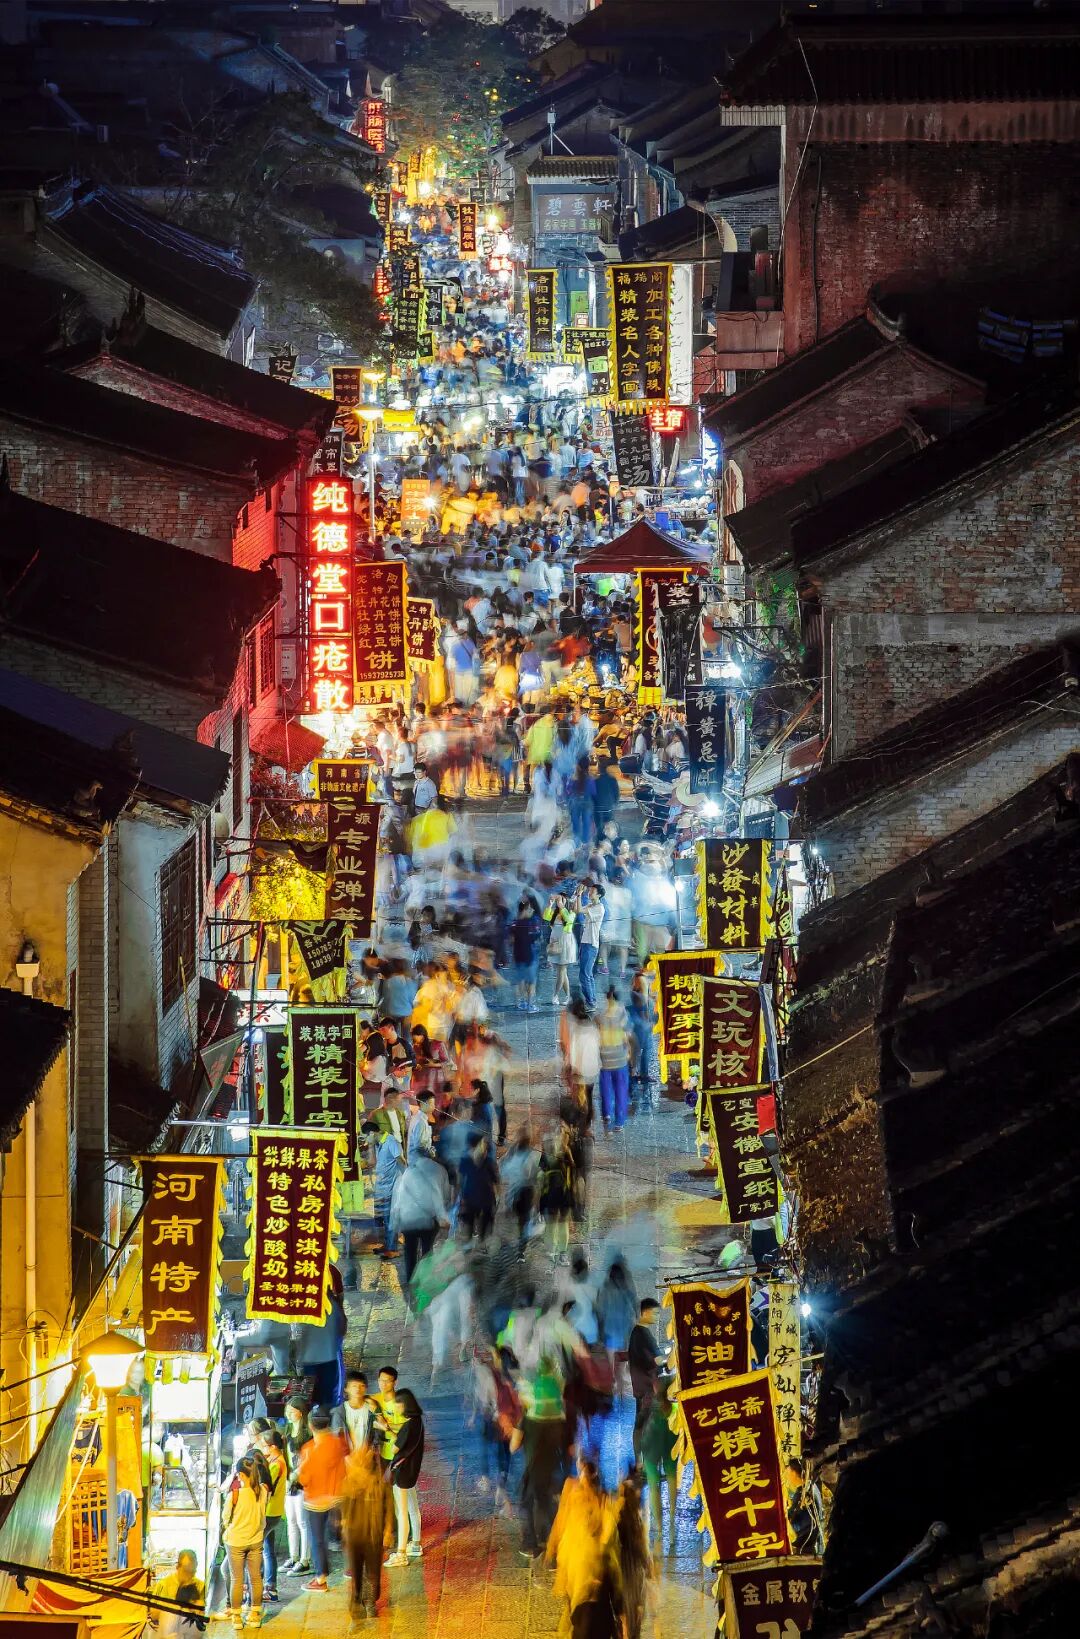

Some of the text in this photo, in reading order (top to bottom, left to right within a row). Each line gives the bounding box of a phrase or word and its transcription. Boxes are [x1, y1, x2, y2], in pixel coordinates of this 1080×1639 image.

[533, 275, 551, 336] 洛阳牡丹特产
[617, 289, 641, 394] 精装名人字画
[643, 288, 665, 393] 加工各种佛珠
[311, 481, 350, 711] 纯德堂口疮散
[355, 595, 401, 609] 牡丹花饼
[357, 609, 401, 622] 牡丹饼
[358, 622, 402, 636] 绿豆饼
[358, 635, 402, 649] 红豆饼
[359, 670, 405, 680] 15937925738
[364, 650, 398, 670] 饼
[304, 1042, 350, 1128] 精装十字
[146, 1172, 205, 1335] 河南特产
[262, 1171, 298, 1279] 特色炒酸奶
[293, 1173, 330, 1279] 私房冰淇淋
[692, 1396, 765, 1428] 艺宝斋
[711, 1425, 785, 1559] 精装十字
[740, 1578, 821, 1606] 金属软
